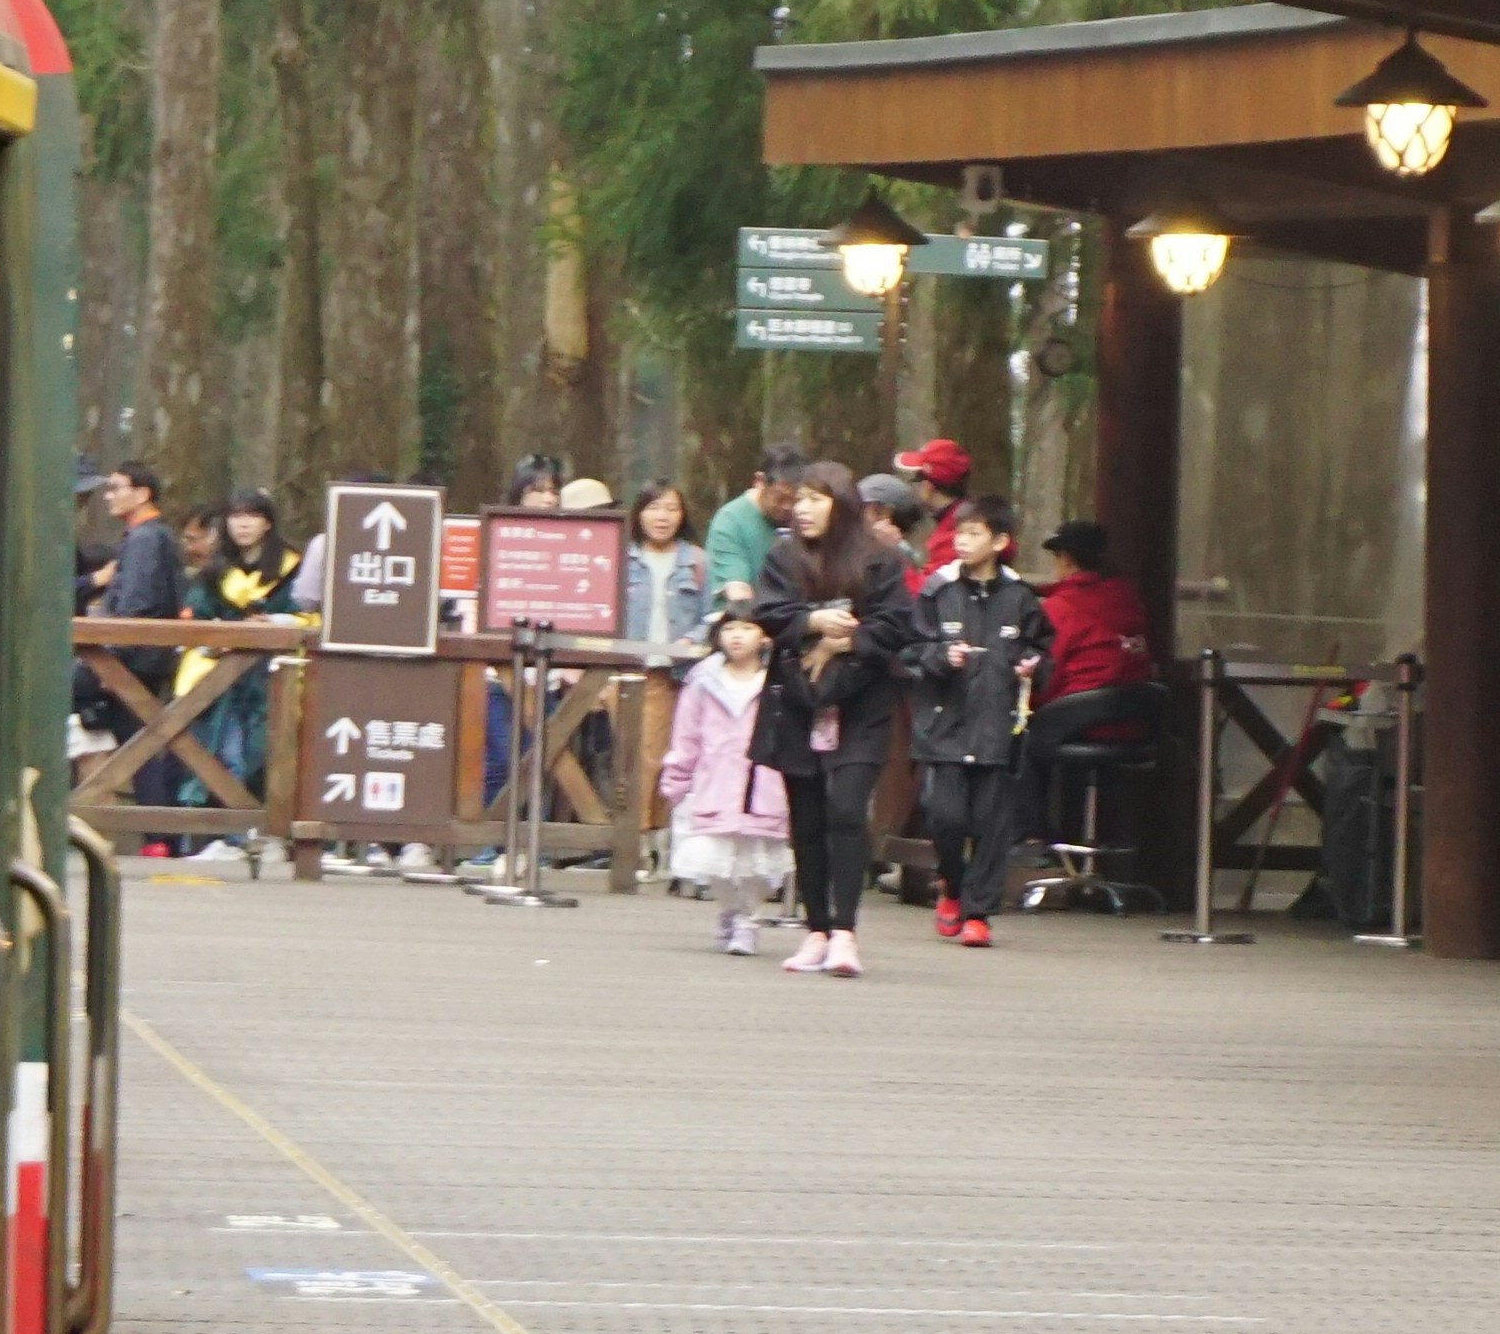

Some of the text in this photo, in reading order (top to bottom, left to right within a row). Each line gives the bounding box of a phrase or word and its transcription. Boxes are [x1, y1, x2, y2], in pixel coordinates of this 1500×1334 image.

[349, 551, 416, 586] 出口
[365, 720, 446, 749] 售票處
